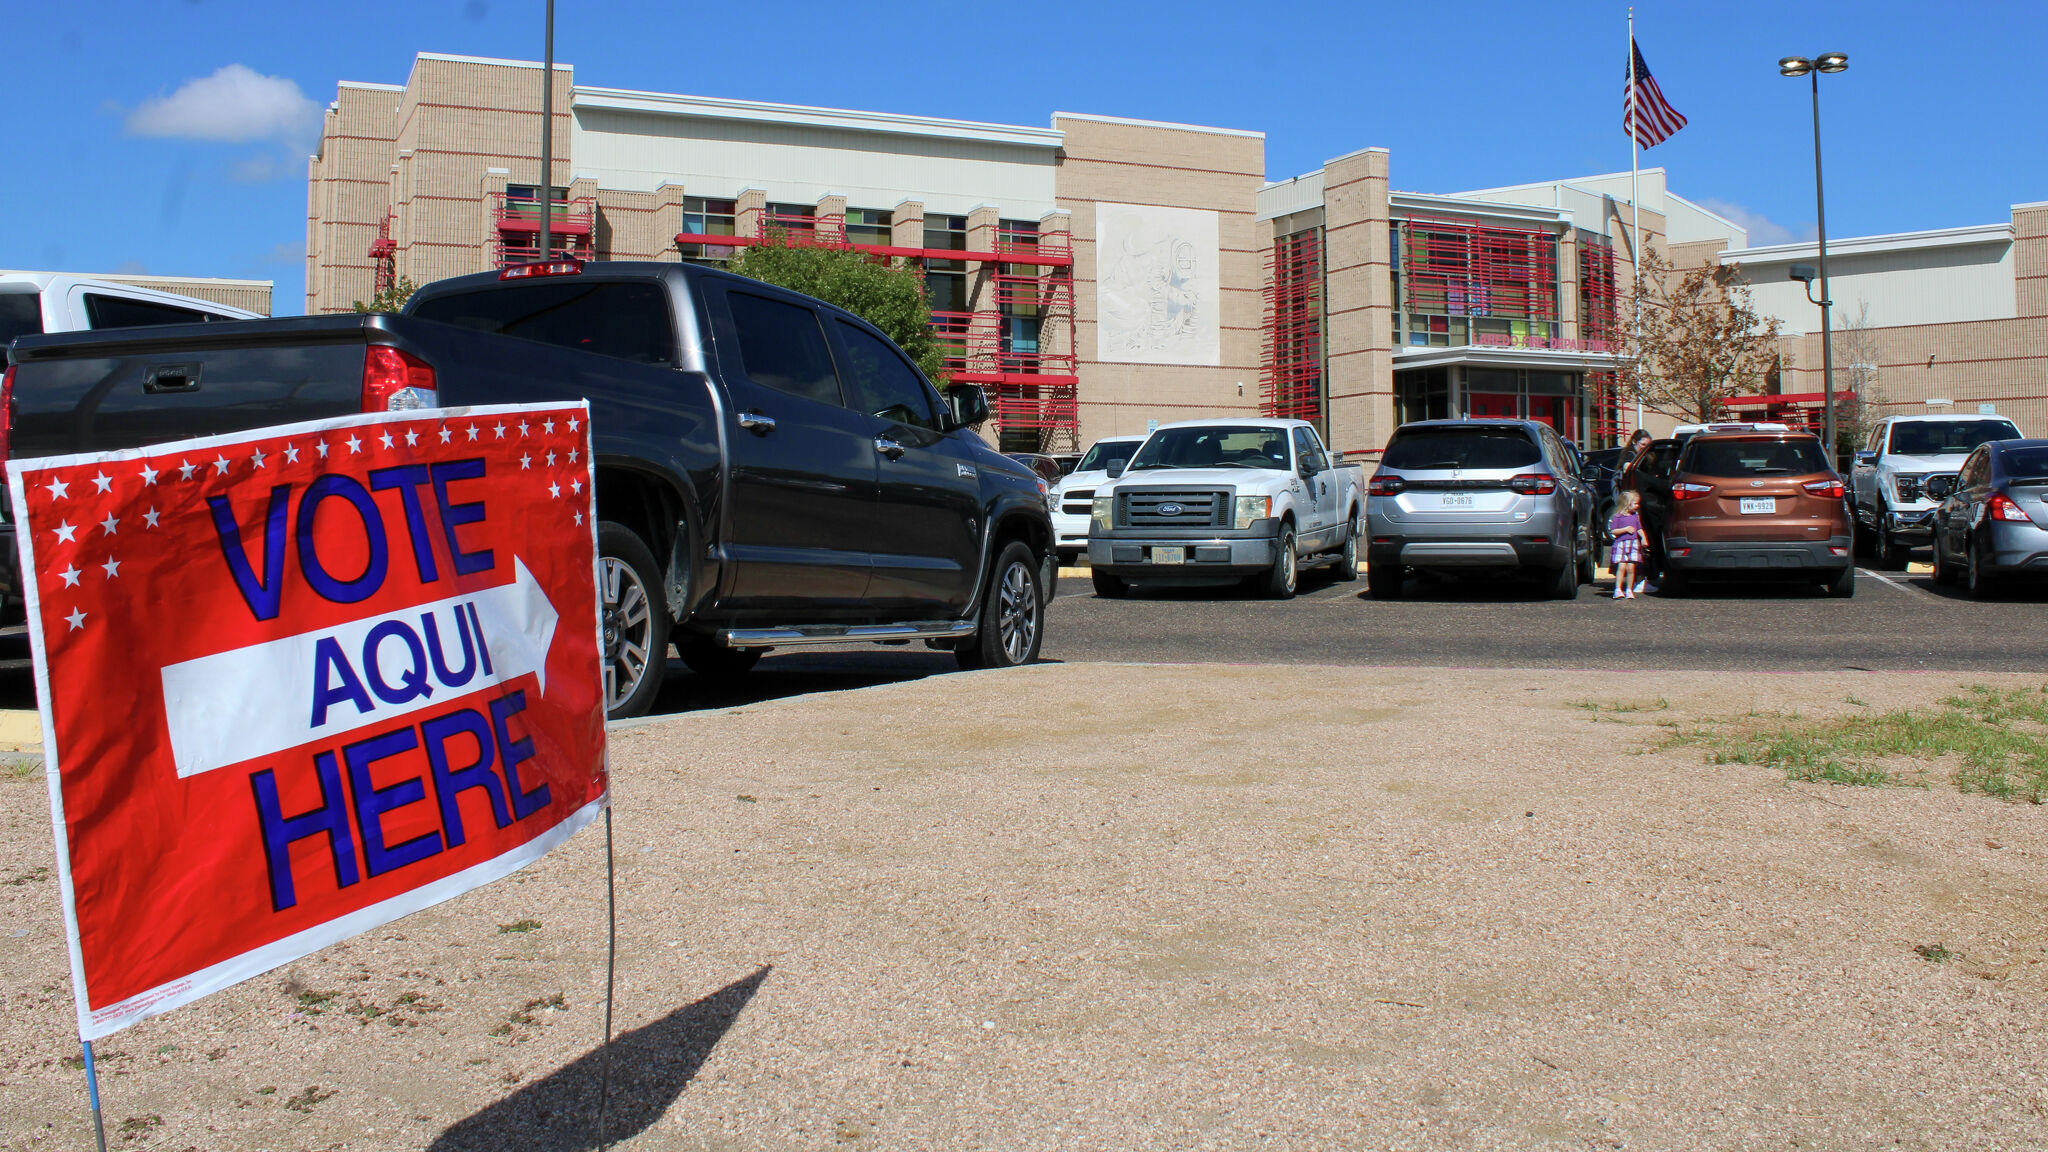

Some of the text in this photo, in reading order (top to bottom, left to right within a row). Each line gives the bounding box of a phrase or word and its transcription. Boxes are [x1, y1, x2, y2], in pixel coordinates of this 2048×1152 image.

[1472, 333, 1519, 346] LAREDO
[1522, 335, 1547, 348] FIRE
[205, 457, 495, 621] VOTE
[310, 601, 493, 728] AQUI
[249, 689, 552, 913] HERE
